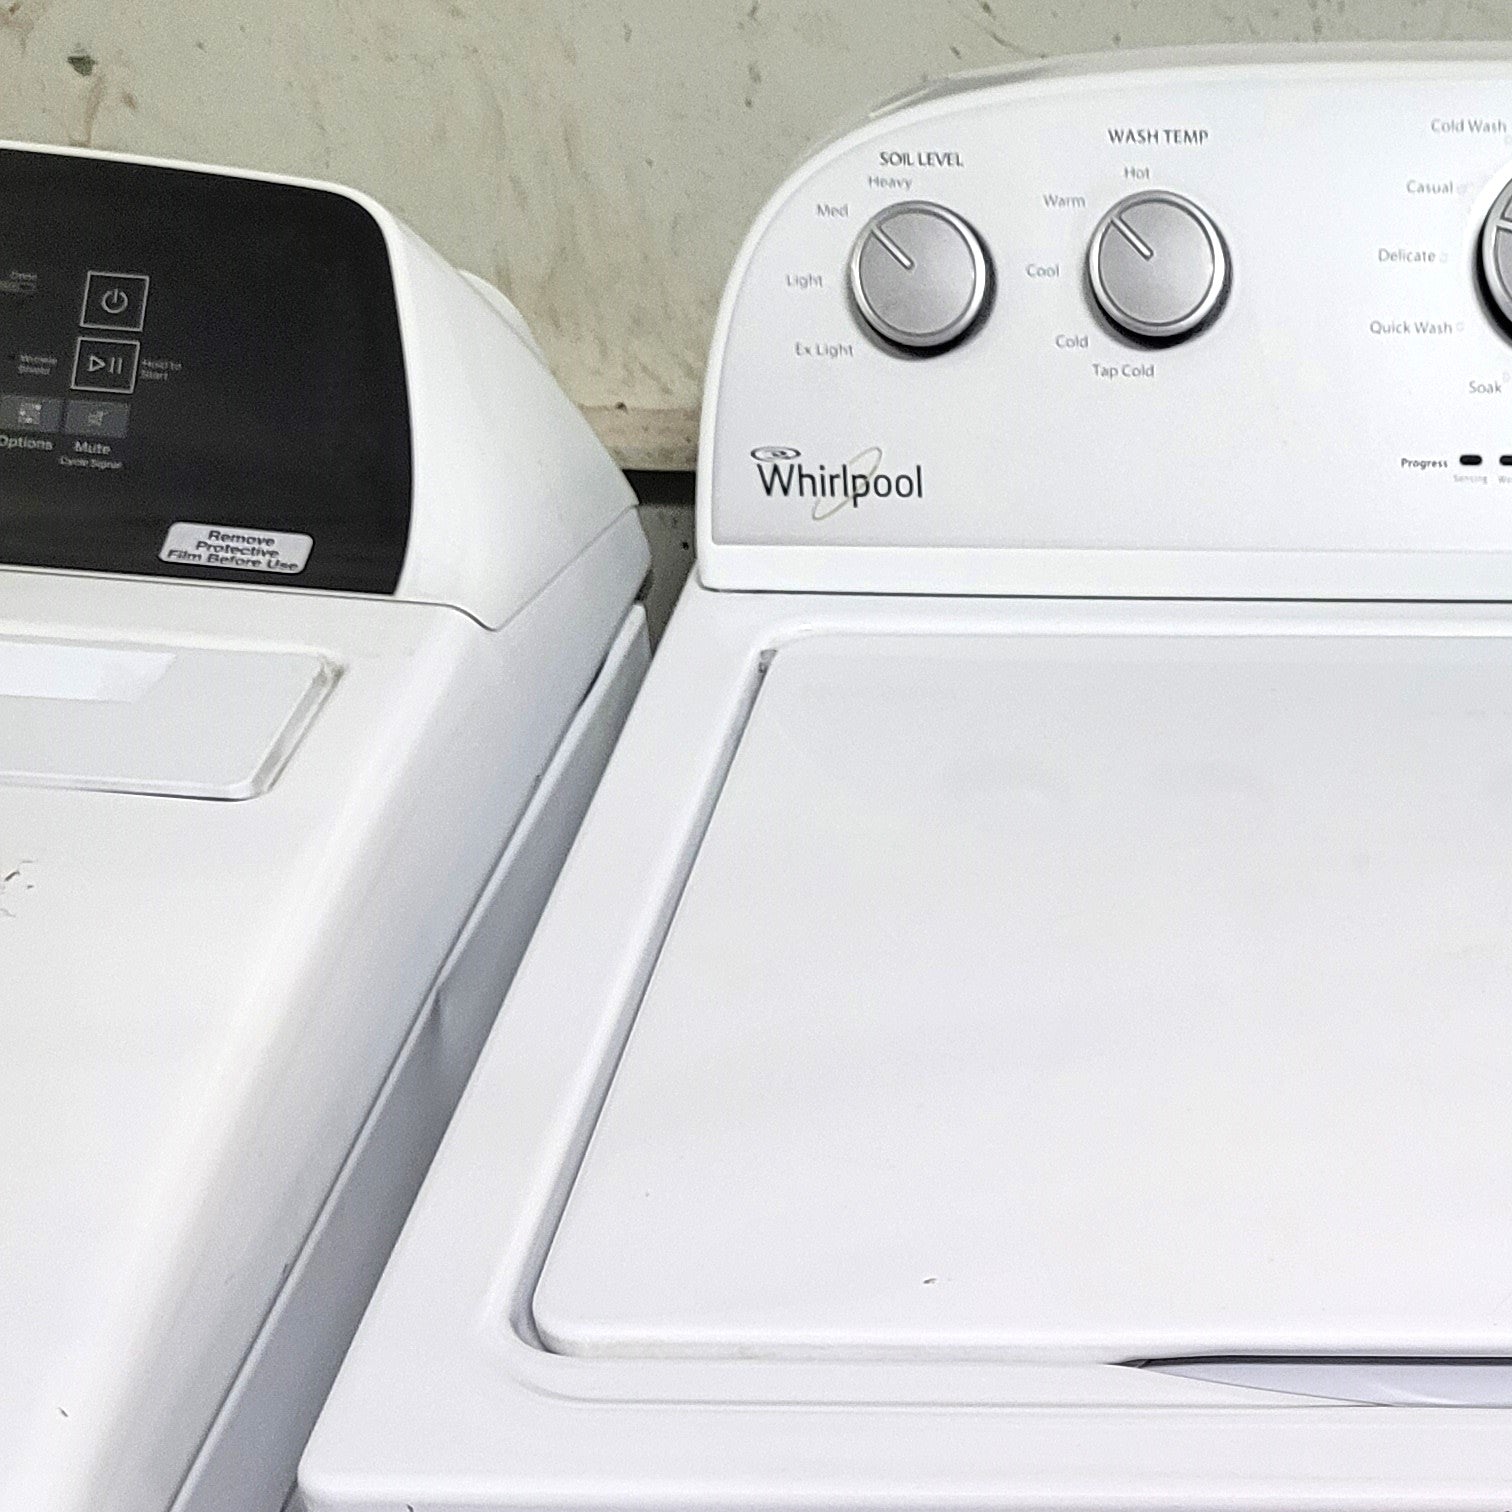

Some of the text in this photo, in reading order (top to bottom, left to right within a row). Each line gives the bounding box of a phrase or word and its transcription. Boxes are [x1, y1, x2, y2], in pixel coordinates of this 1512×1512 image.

[1432, 120, 1507, 133] Cold Wash
[1109, 129, 1209, 144] WASH TEMP
[880, 152, 963, 167] SOIL LEVEL
[1125, 167, 1150, 179] Hot
[869, 175, 912, 191] Heavy
[1407, 181, 1453, 194] Casual
[1044, 195, 1086, 208] Warm
[817, 204, 848, 218] Med
[1378, 249, 1436, 263] Delicate
[1027, 264, 1060, 277] Cool
[787, 274, 823, 289] Light
[1370, 321, 1453, 336] Quick Wash
[1056, 335, 1088, 349] Cold
[795, 343, 853, 359] Ex Light
[1093, 364, 1154, 379] Tap Cold
[1469, 381, 1502, 394] Soak
[0, 435, 53, 451] Options
[75, 442, 111, 455] Mute
[1401, 458, 1448, 470] Progress
[757, 464, 923, 507] Whirlpool
[208, 530, 275, 546] Remove
[196, 541, 279, 558] Protective
[167, 549, 298, 570] Film Before Use
